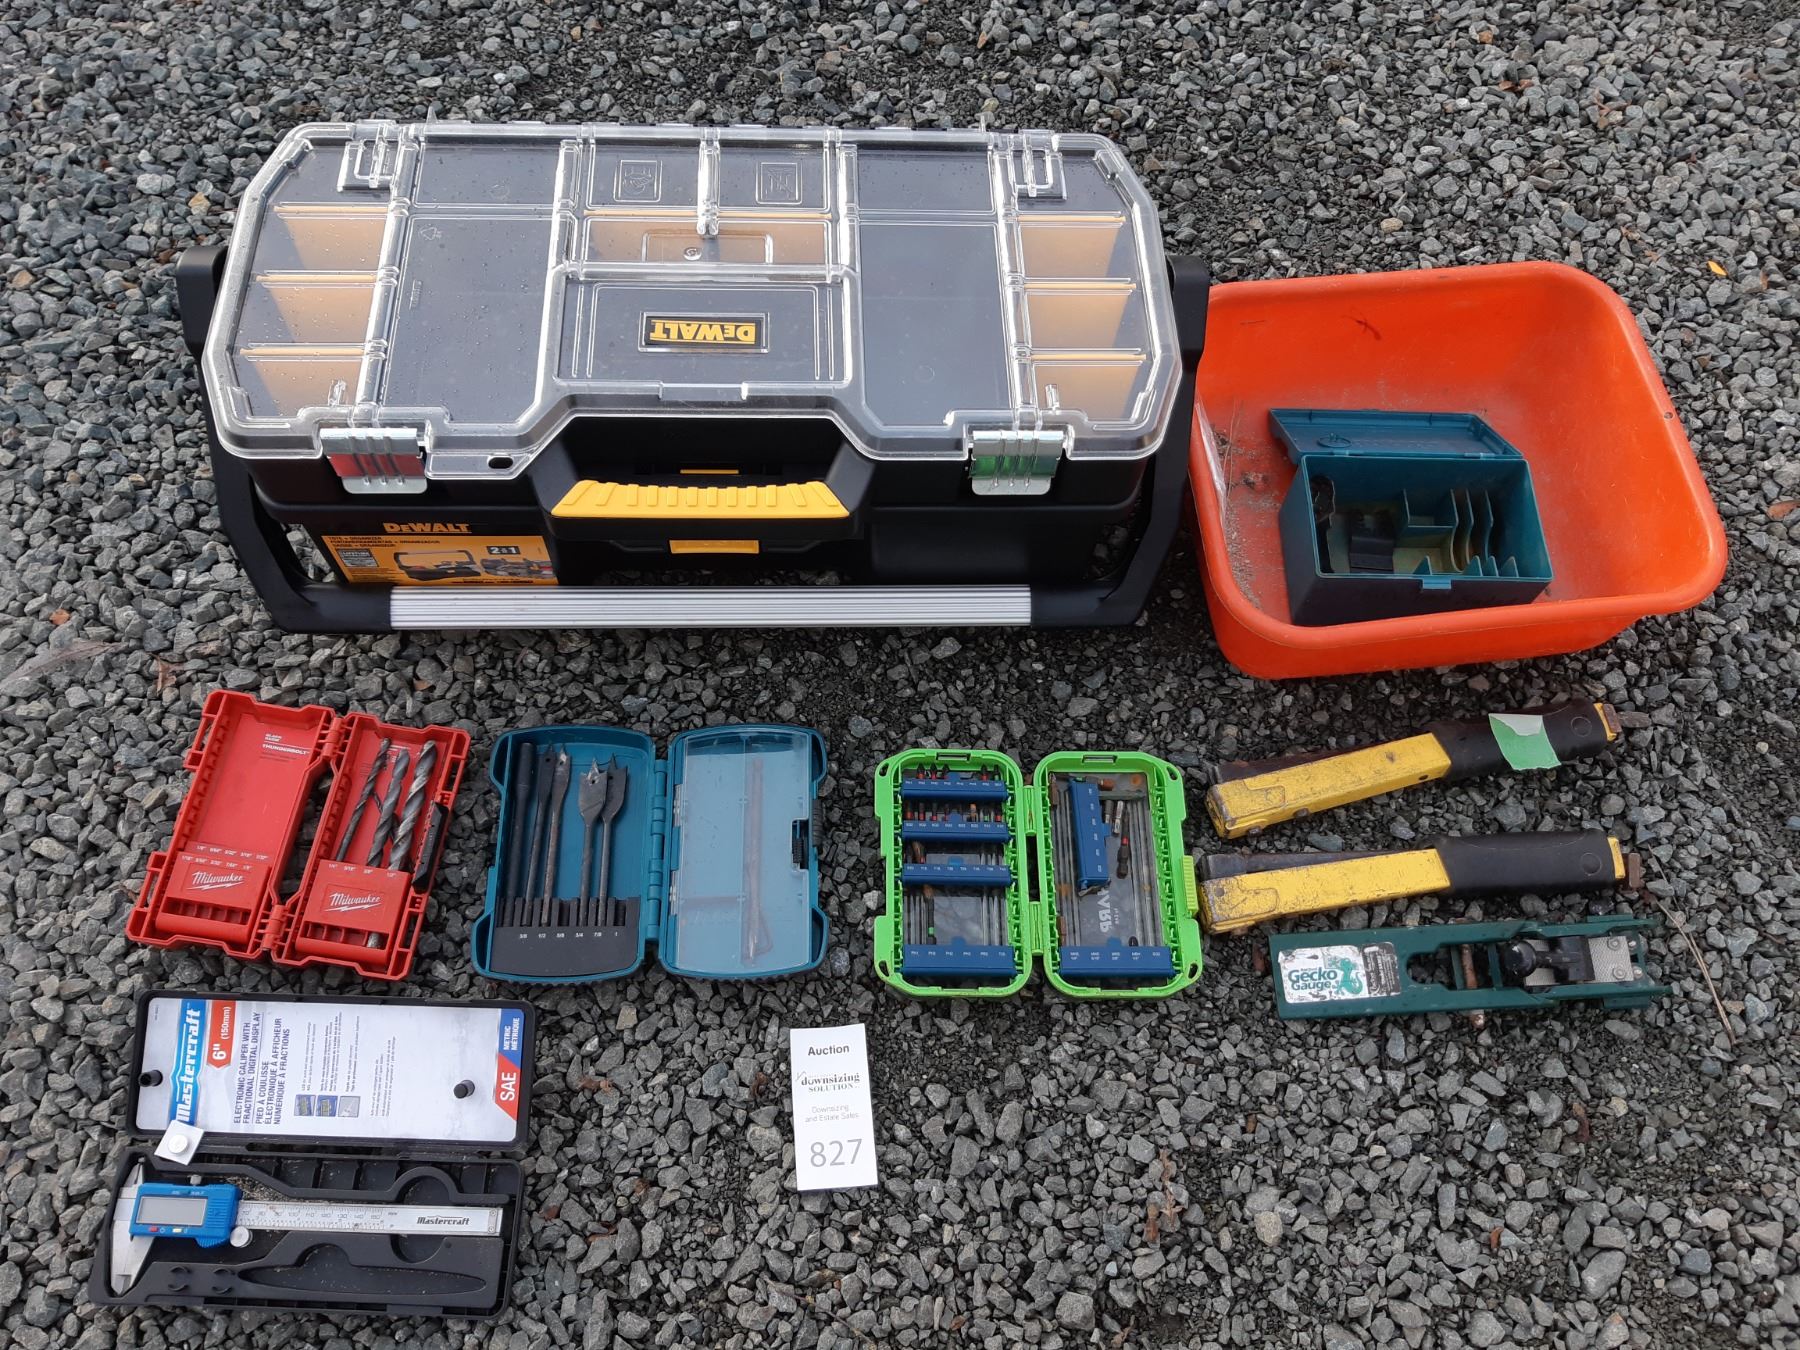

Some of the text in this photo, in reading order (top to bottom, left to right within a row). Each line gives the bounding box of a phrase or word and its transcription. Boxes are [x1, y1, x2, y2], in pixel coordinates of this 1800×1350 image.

[650, 320, 756, 344] DEWALT
[383, 522, 471, 533] DEWALT
[192, 870, 244, 885] Milwaukee
[329, 892, 382, 906] Milwaukee
[1288, 966, 1338, 983] Gecko
[1291, 980, 1332, 991] Gauge
[221, 1006, 232, 1040] (150mm)
[271, 1018, 282, 1059] AFFICHEUR
[280, 1028, 290, 1071] FRACTIONS
[503, 1025, 511, 1051] METRIC
[808, 1045, 850, 1056] Auction
[176, 1008, 201, 1122] Mastercraft
[233, 1022, 251, 1124] ELECTRONIC CALIPER WITH
[242, 1012, 261, 1124] FRACTIONAL DIGITAL DISPLAY
[258, 1060, 269, 1098] COULISSE
[500, 1071, 517, 1102] SAE
[801, 1072, 861, 1086] downsizing
[255, 1107, 265, 1125] PIED
[810, 1138, 863, 1168] 827
[416, 1216, 470, 1226] Mastercraft
